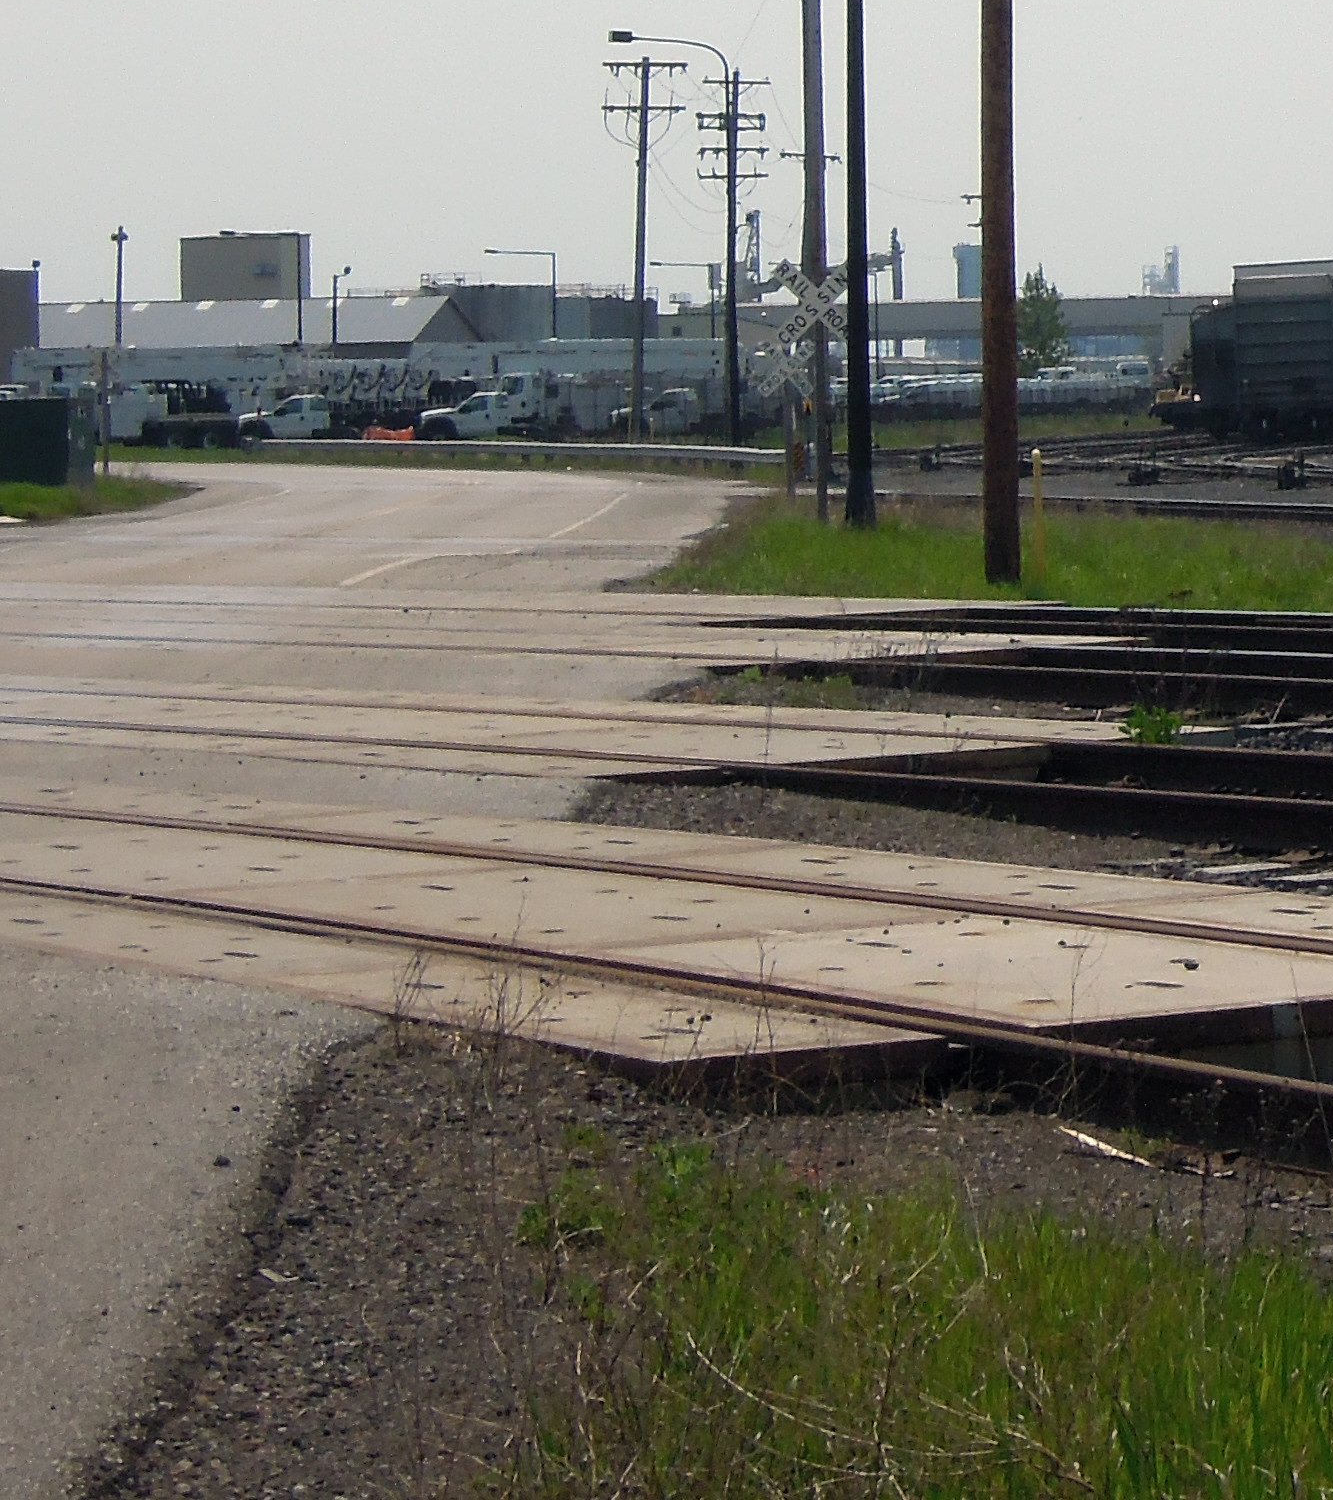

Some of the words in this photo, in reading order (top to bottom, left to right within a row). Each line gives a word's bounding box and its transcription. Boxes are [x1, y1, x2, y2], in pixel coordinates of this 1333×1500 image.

[776, 263, 809, 298] RAIL
[823, 308, 848, 339] ROA
[778, 272, 848, 344] CROSSIN
